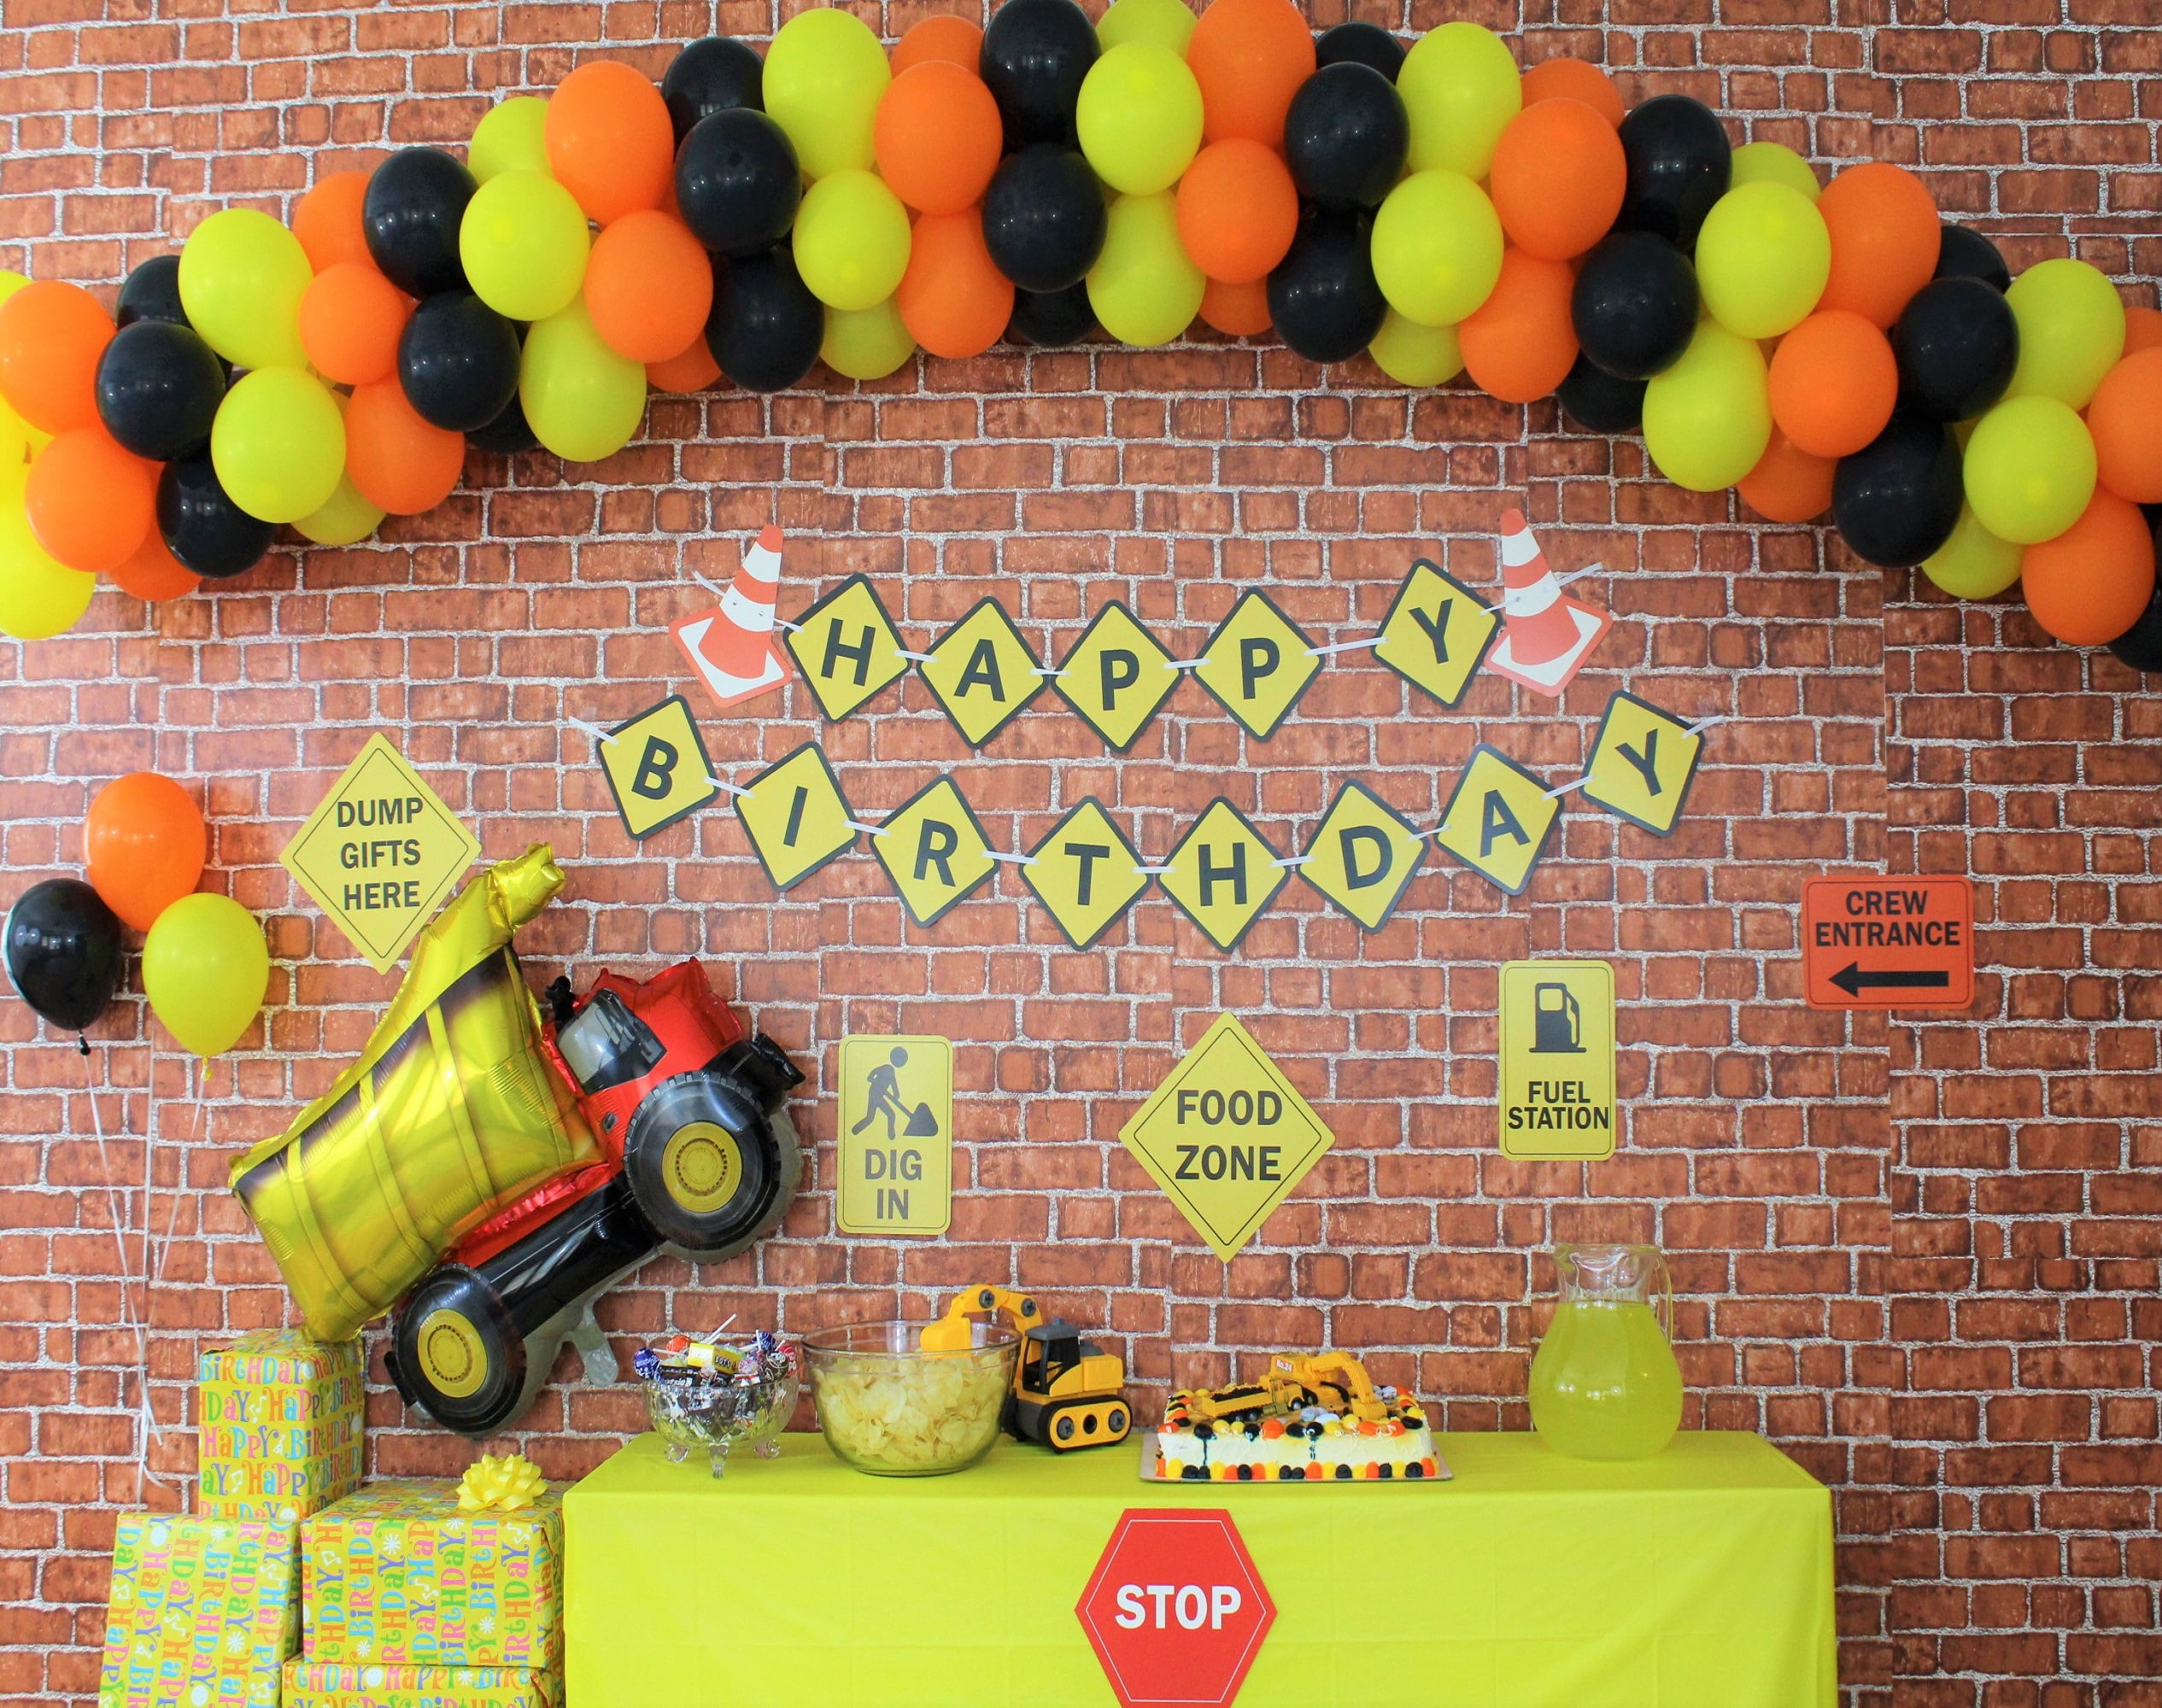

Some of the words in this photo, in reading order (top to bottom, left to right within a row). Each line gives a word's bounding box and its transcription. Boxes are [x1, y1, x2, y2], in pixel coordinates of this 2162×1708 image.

[821, 598, 1453, 711] HAPPY
[337, 797, 423, 828] DUMP
[631, 728, 1661, 906] BIRTHDAY
[340, 839, 421, 869] GIFTS
[344, 880, 420, 910] HERE
[1846, 890, 1928, 915] CREW
[1815, 921, 1960, 947] ENTRANCE
[1528, 1080, 1591, 1103] FUEL
[1177, 1090, 1283, 1126] FOOD
[1508, 1106, 1608, 1130] STATION
[864, 1149, 923, 1180] DIG
[1175, 1144, 1281, 1181] ZONE
[876, 1188, 909, 1220] IN
[714, 1354, 732, 1368] DOTS
[1115, 1584, 1242, 1629] STOP
